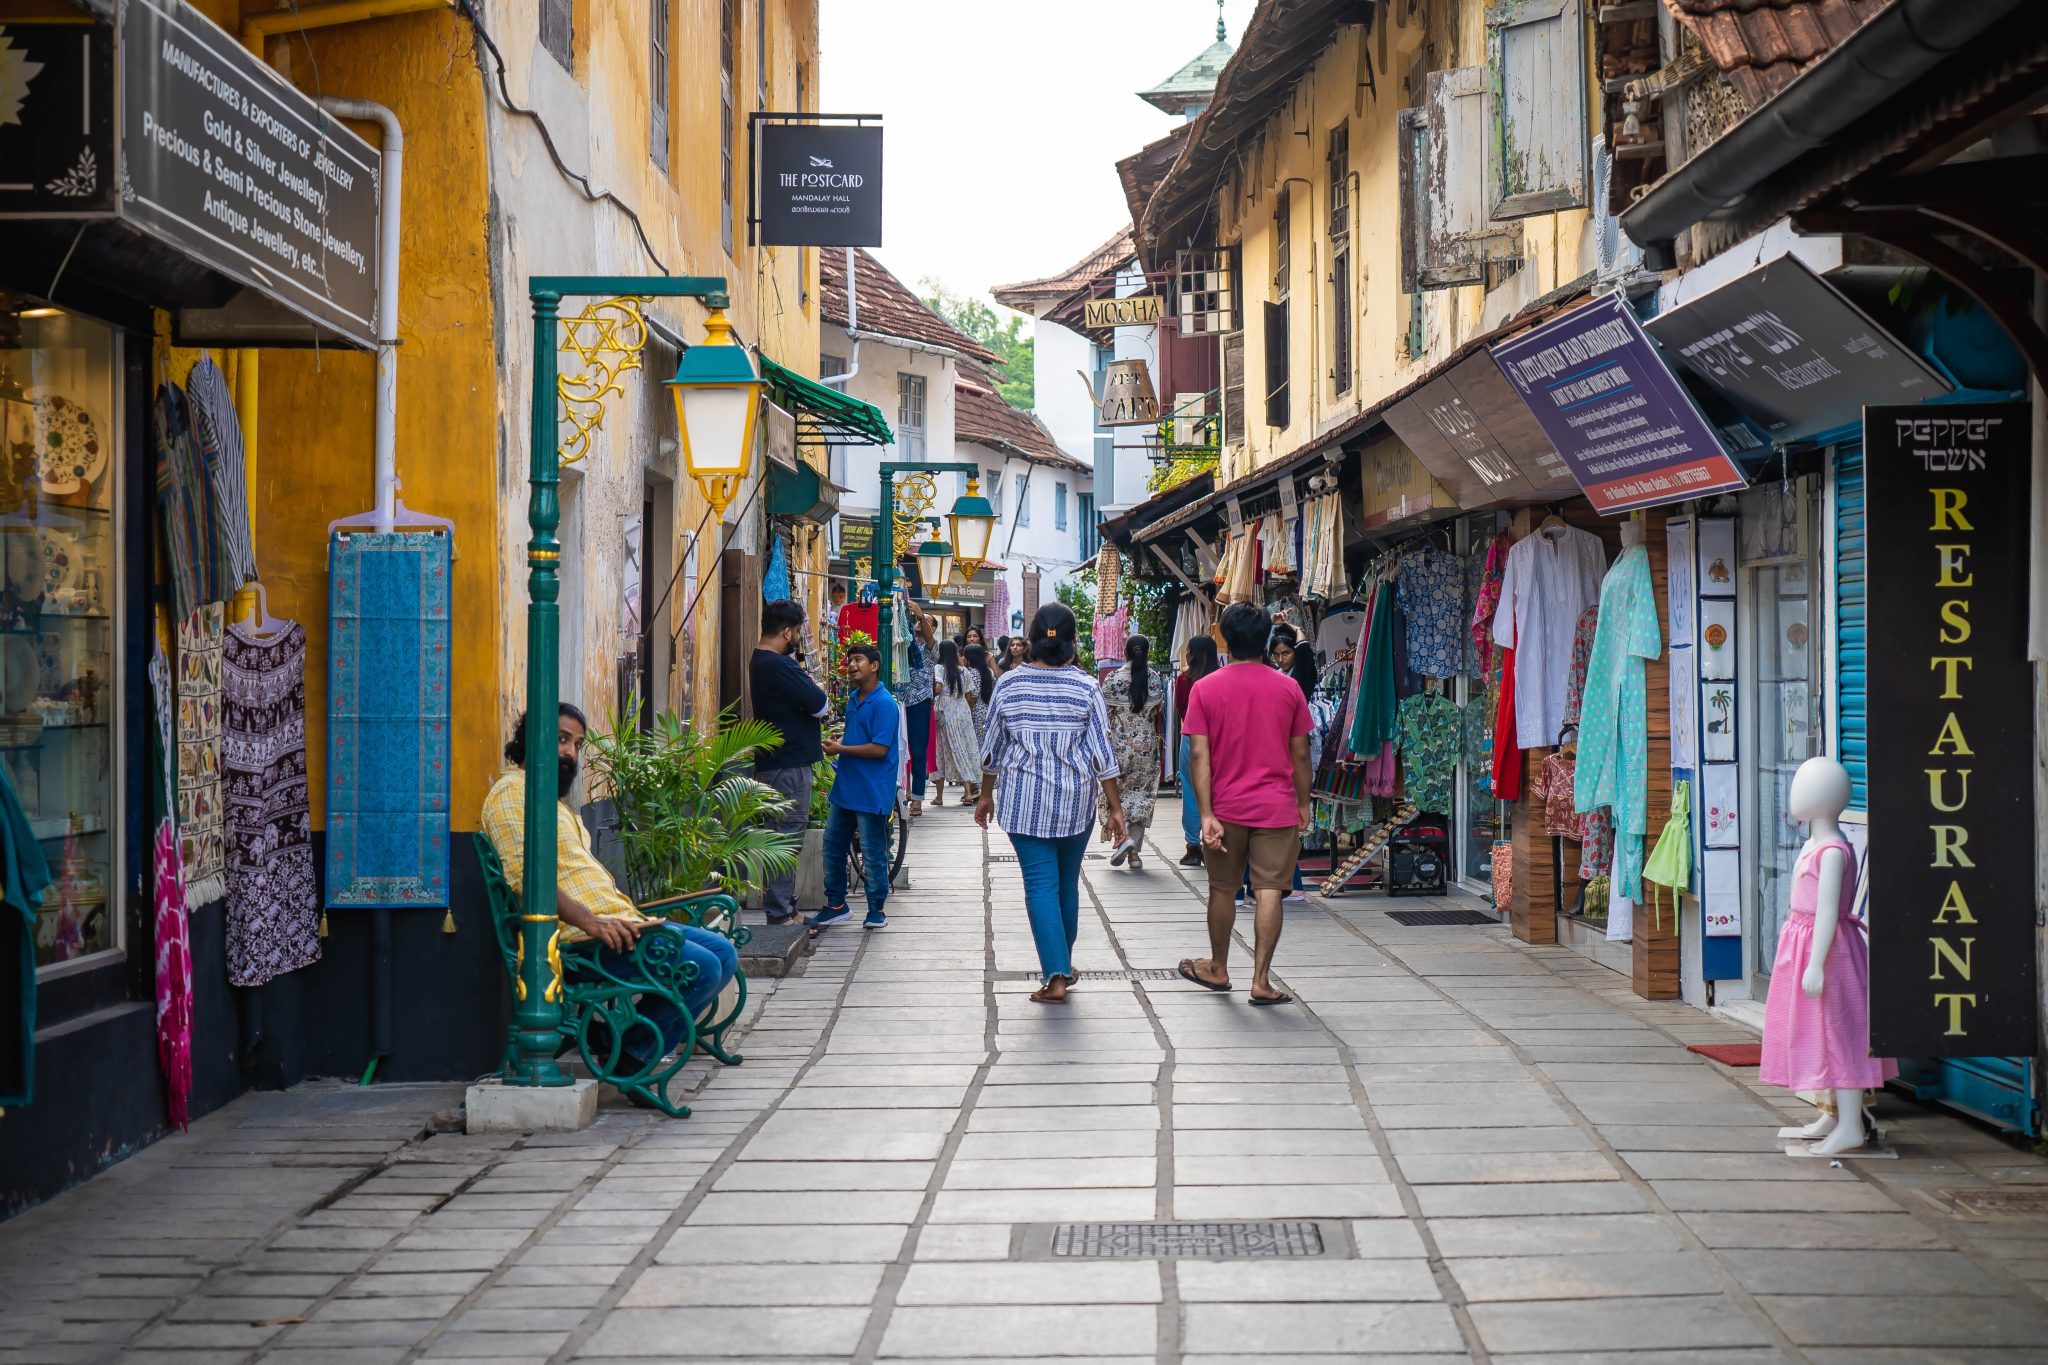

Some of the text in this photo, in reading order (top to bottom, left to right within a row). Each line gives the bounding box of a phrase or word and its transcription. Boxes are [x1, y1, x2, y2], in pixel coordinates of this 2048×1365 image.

[162, 39, 354, 191] MANUFACTURES & EXPORTERS OF JEWELLERY
[203, 110, 326, 214] Gold & Silver Jewellery,
[780, 173, 864, 188] THE POSTCARD
[143, 111, 366, 275] Precious & Semi Precious Stone Jewellery,
[203, 190, 248, 236] Antique
[250, 218, 300, 269] Jewellery,
[1087, 298, 1161, 325] MOCHA
[1517, 317, 1635, 383] LITTLE QUEEN HAND EMBROIDERY
[1761, 348, 1842, 391] Restaurant
[1110, 373, 1141, 386] ART
[1568, 379, 1594, 399] VILLAGE
[1607, 365, 1631, 386] WORK
[1427, 398, 1478, 436] LOTUS
[1467, 449, 1519, 485] INDIA
[1924, 488, 1978, 1036] RESTAURANT
